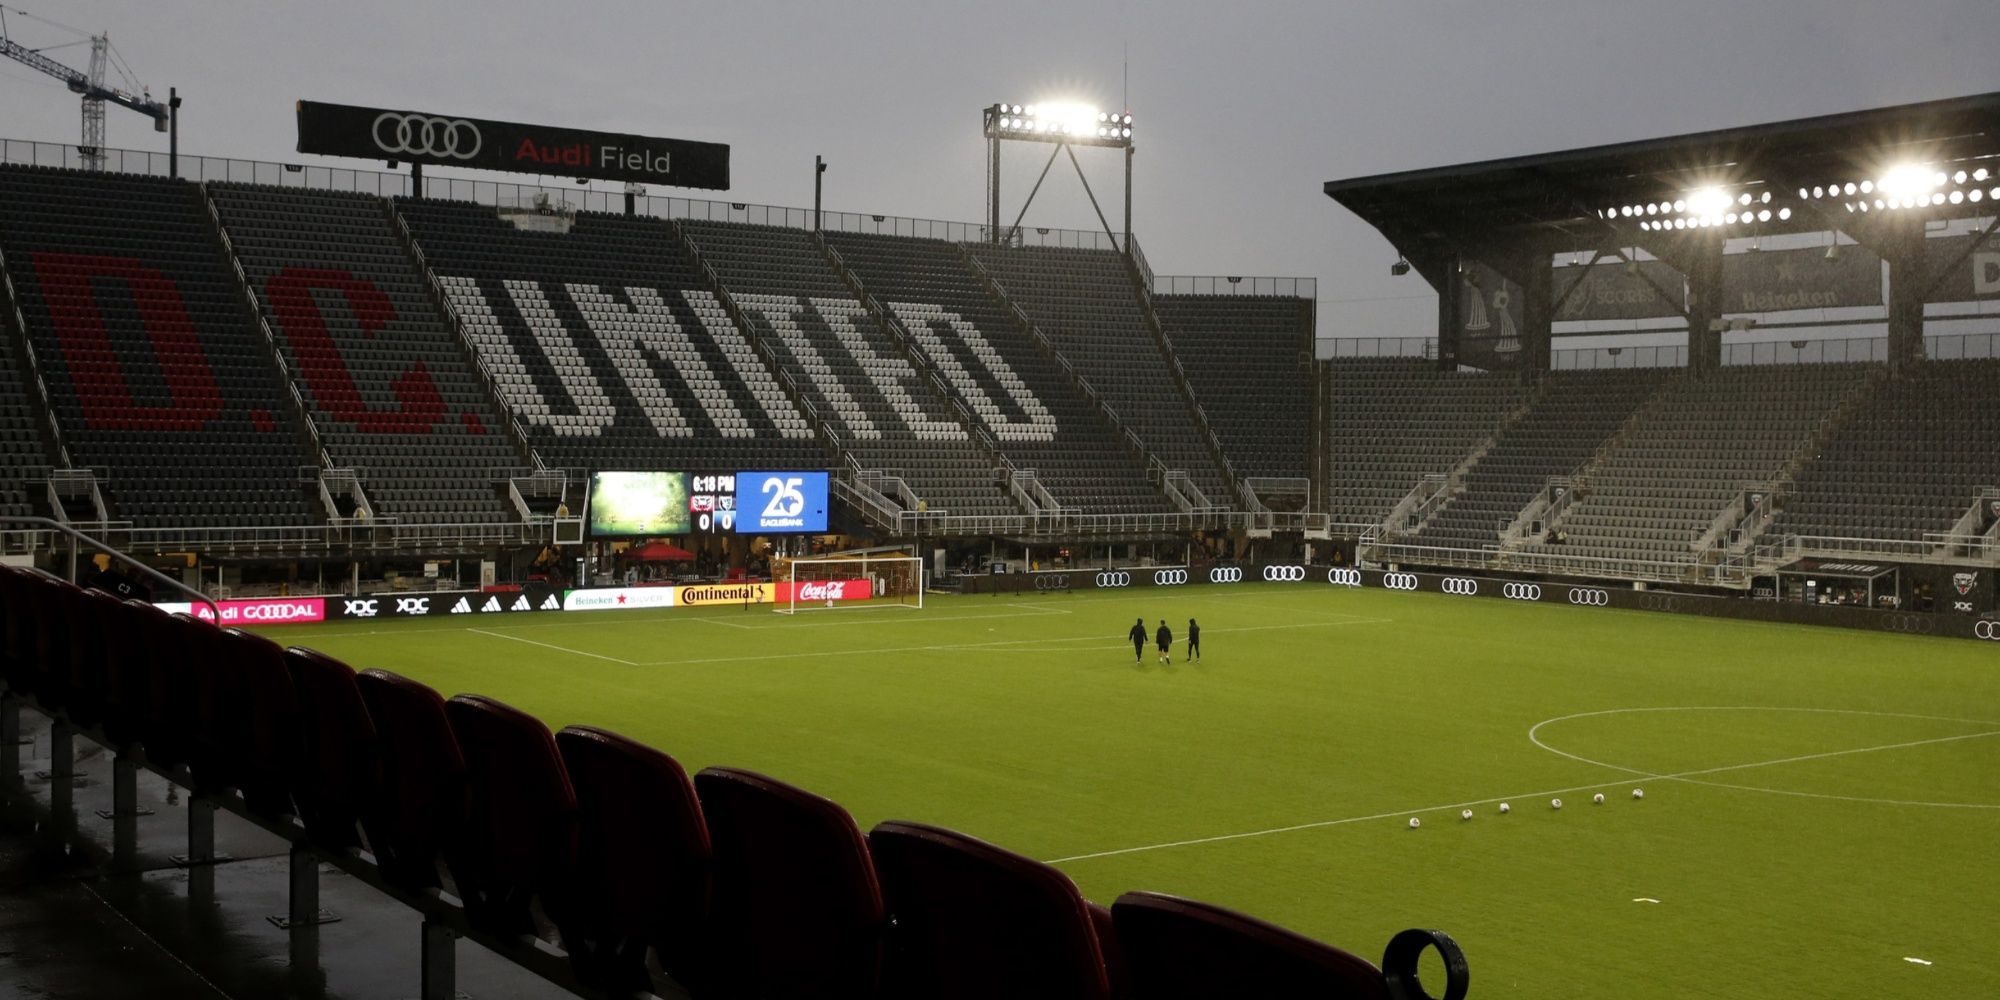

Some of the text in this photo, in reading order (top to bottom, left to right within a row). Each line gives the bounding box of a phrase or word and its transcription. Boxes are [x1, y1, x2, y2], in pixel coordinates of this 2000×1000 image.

[516, 137, 671, 174] Audi Field
[1742, 289, 1840, 310] Heineken
[32, 252, 1058, 441] D.C. UNITED
[693, 476, 735, 492] 6:18 PM
[761, 477, 804, 517] 25
[699, 514, 710, 530] 0
[721, 514, 732, 530] 0
[118, 583, 131, 594] C3
[682, 585, 754, 605] Continental
[800, 581, 846, 600] Coca-Cola
[344, 600, 378, 614] XDC
[396, 598, 430, 612] XDC
[576, 597, 613, 606] Heineken
